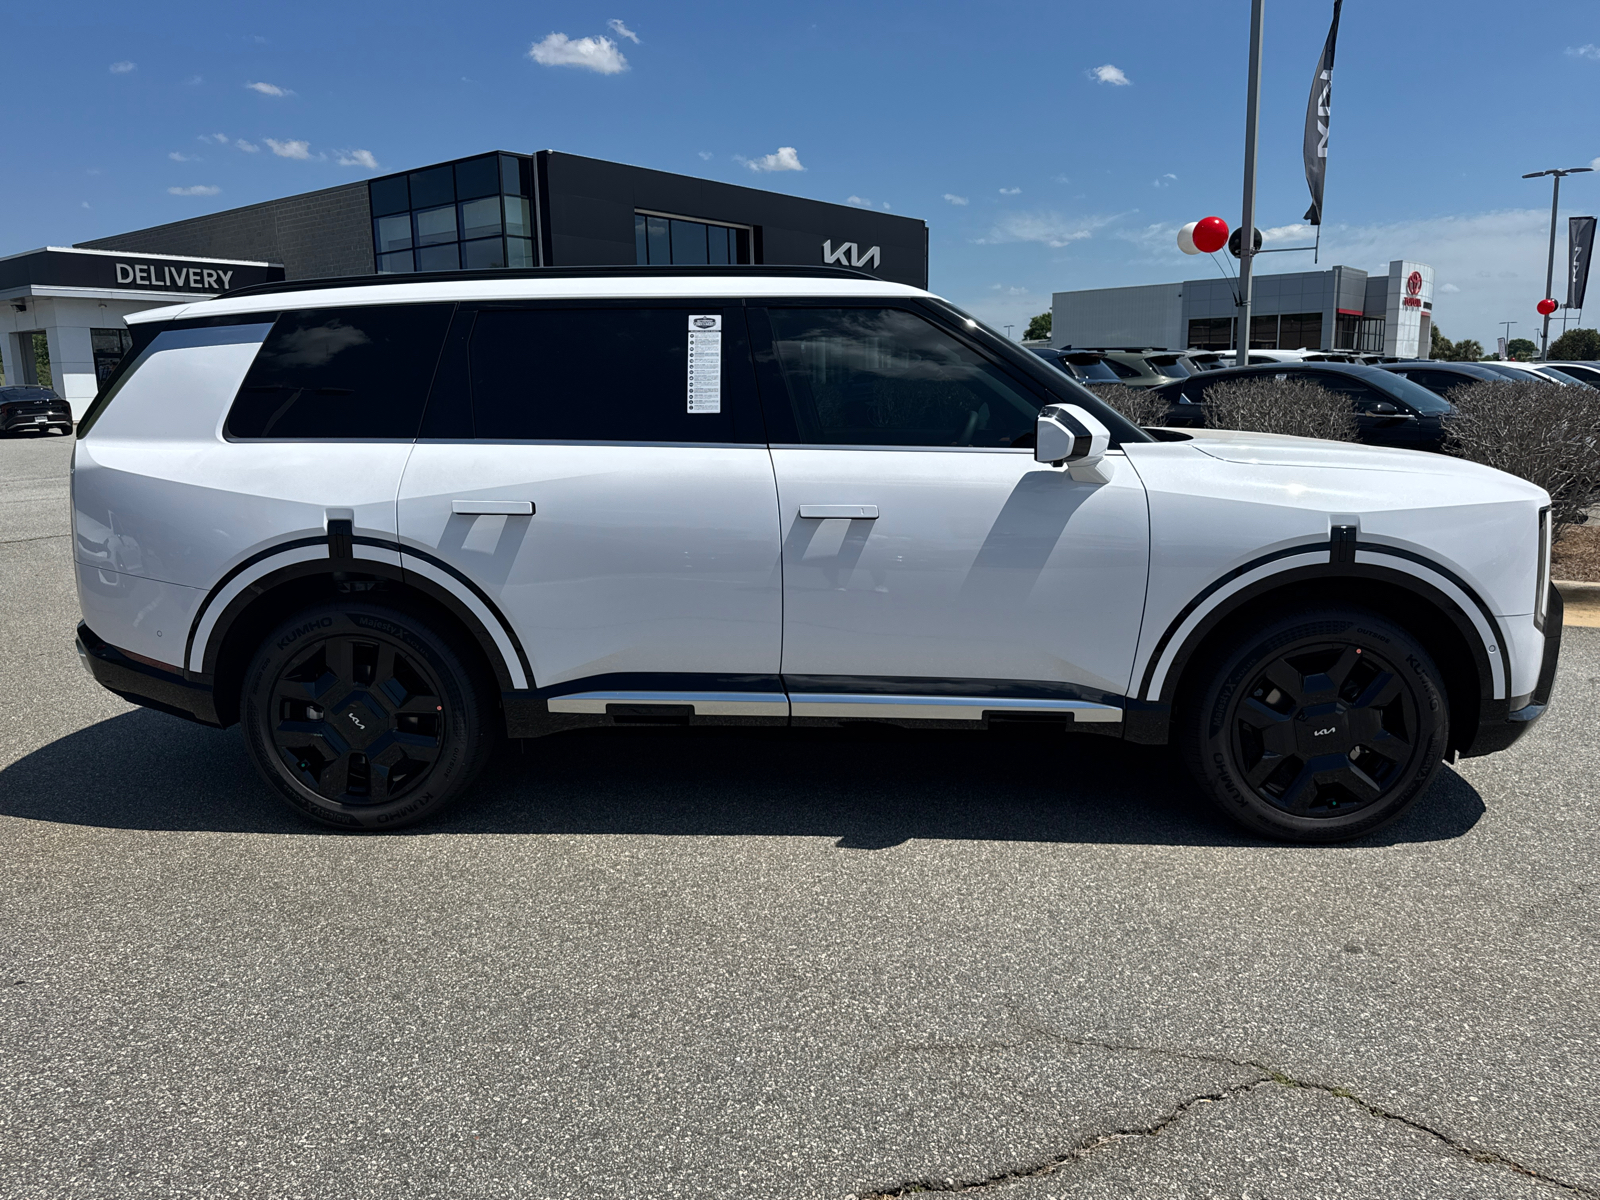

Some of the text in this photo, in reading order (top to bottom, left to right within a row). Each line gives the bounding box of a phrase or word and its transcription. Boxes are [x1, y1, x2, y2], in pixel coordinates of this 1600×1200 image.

[823, 239, 880, 269] KIA
[116, 263, 233, 290] DELIVERY
[276, 617, 332, 650] KUMHO
[1357, 627, 1391, 644] OUTSIDE
[1314, 726, 1336, 737] KIA
[444, 748, 460, 778] OUTSIDE
[1213, 752, 1249, 808] KUMHO
[376, 792, 434, 824] KUMHO
